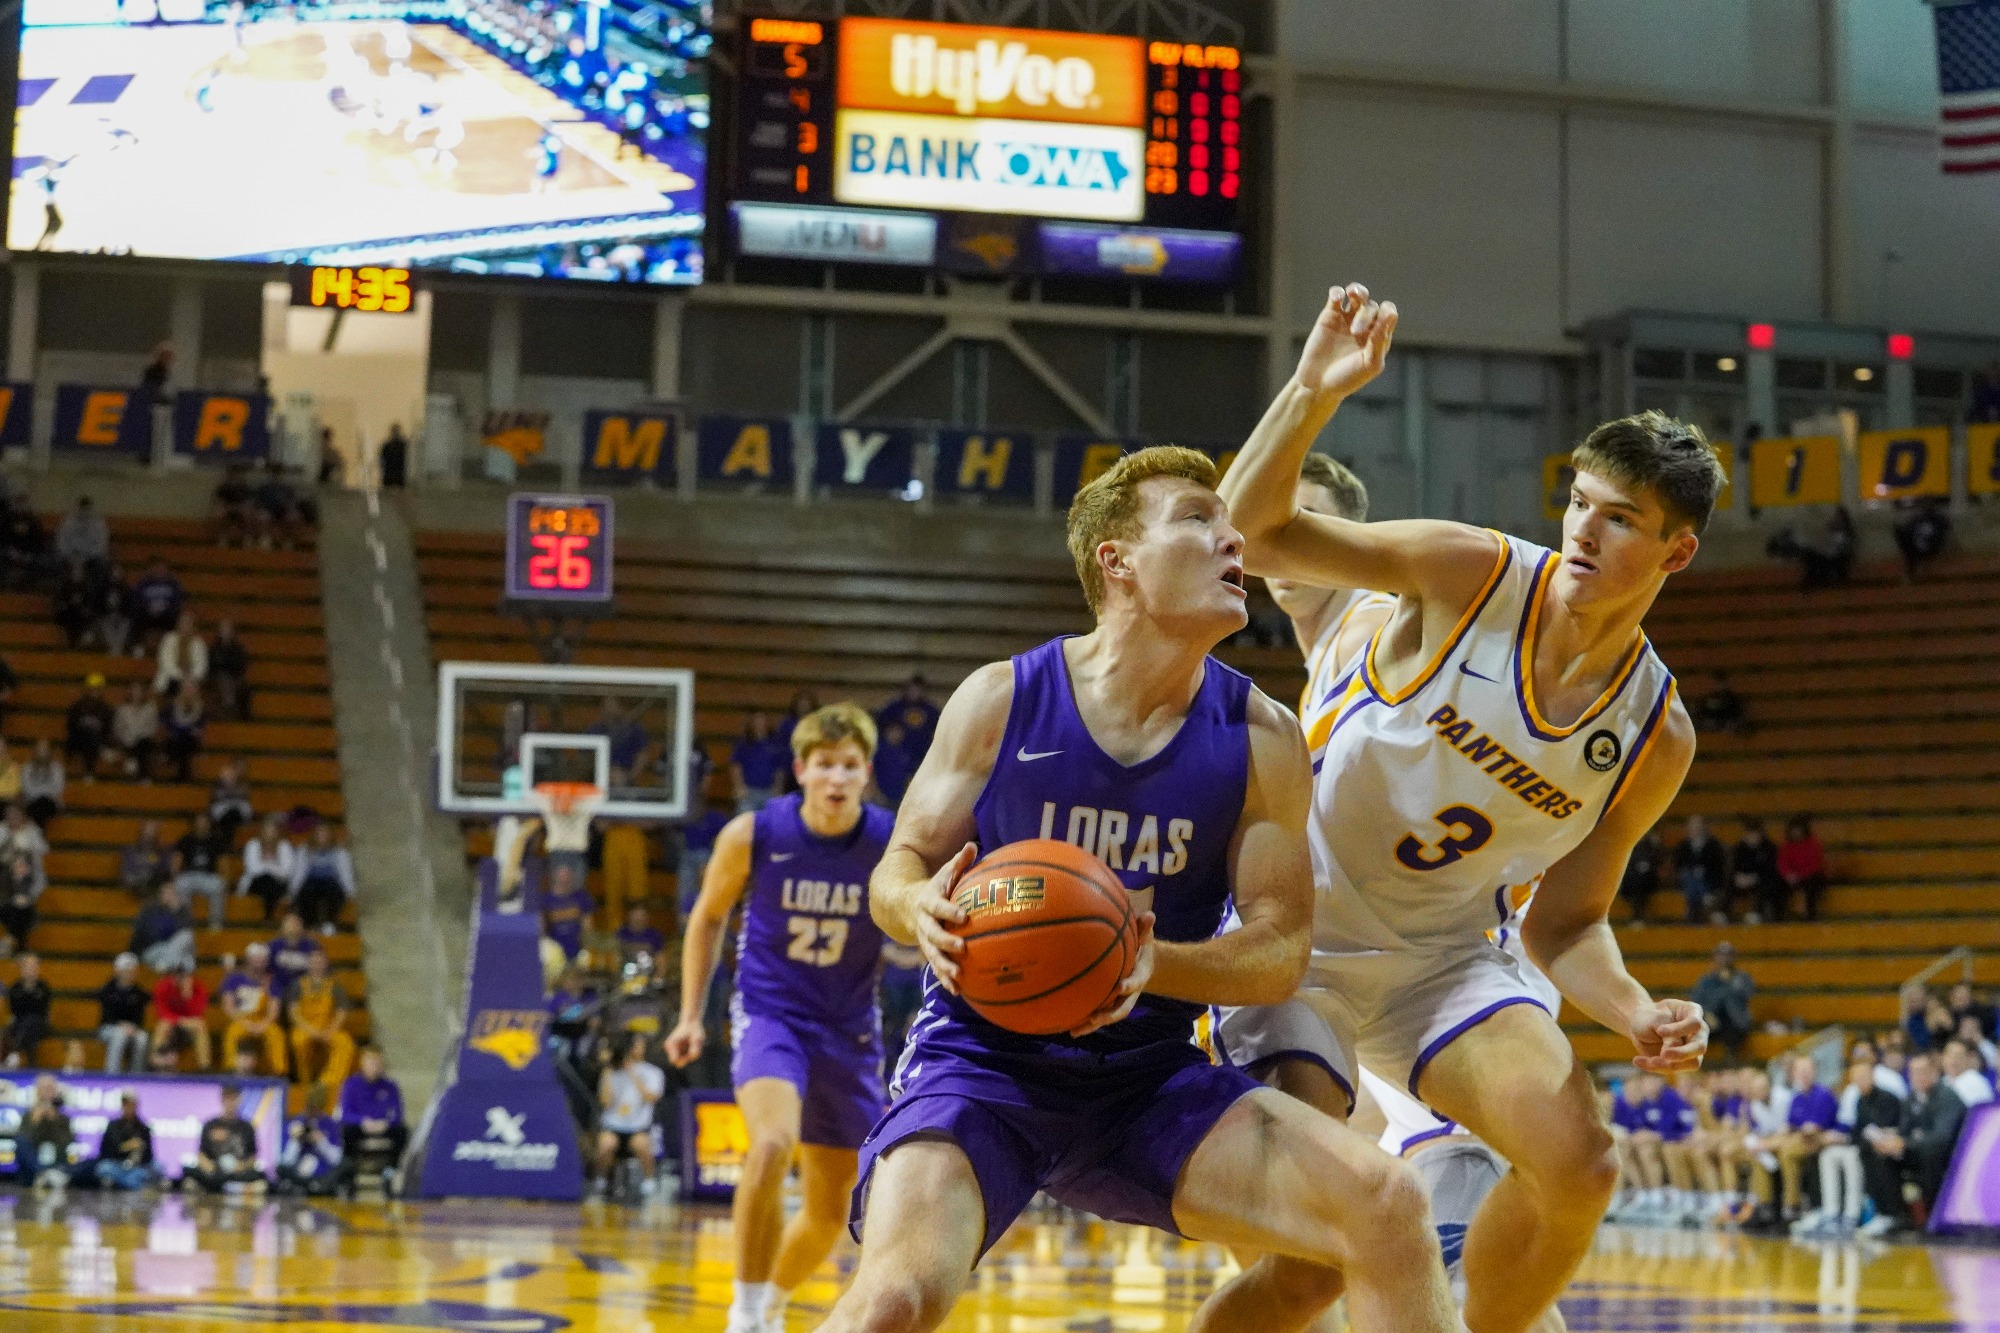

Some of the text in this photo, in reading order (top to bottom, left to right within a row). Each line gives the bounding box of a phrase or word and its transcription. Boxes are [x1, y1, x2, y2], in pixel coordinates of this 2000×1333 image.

[890, 33, 1096, 115] HyVee
[849, 132, 982, 182] BANK
[311, 266, 410, 312] 14:35
[77, 391, 250, 450] E R
[593, 416, 1013, 488] M A Y H
[529, 535, 592, 589] 26
[1425, 704, 1585, 820] PANTHERS
[1039, 801, 1194, 876] LORAS
[1394, 802, 1496, 872] 3
[782, 878, 862, 917] LORAS
[956, 876, 1045, 915] ELITE
[787, 915, 849, 968] 23
